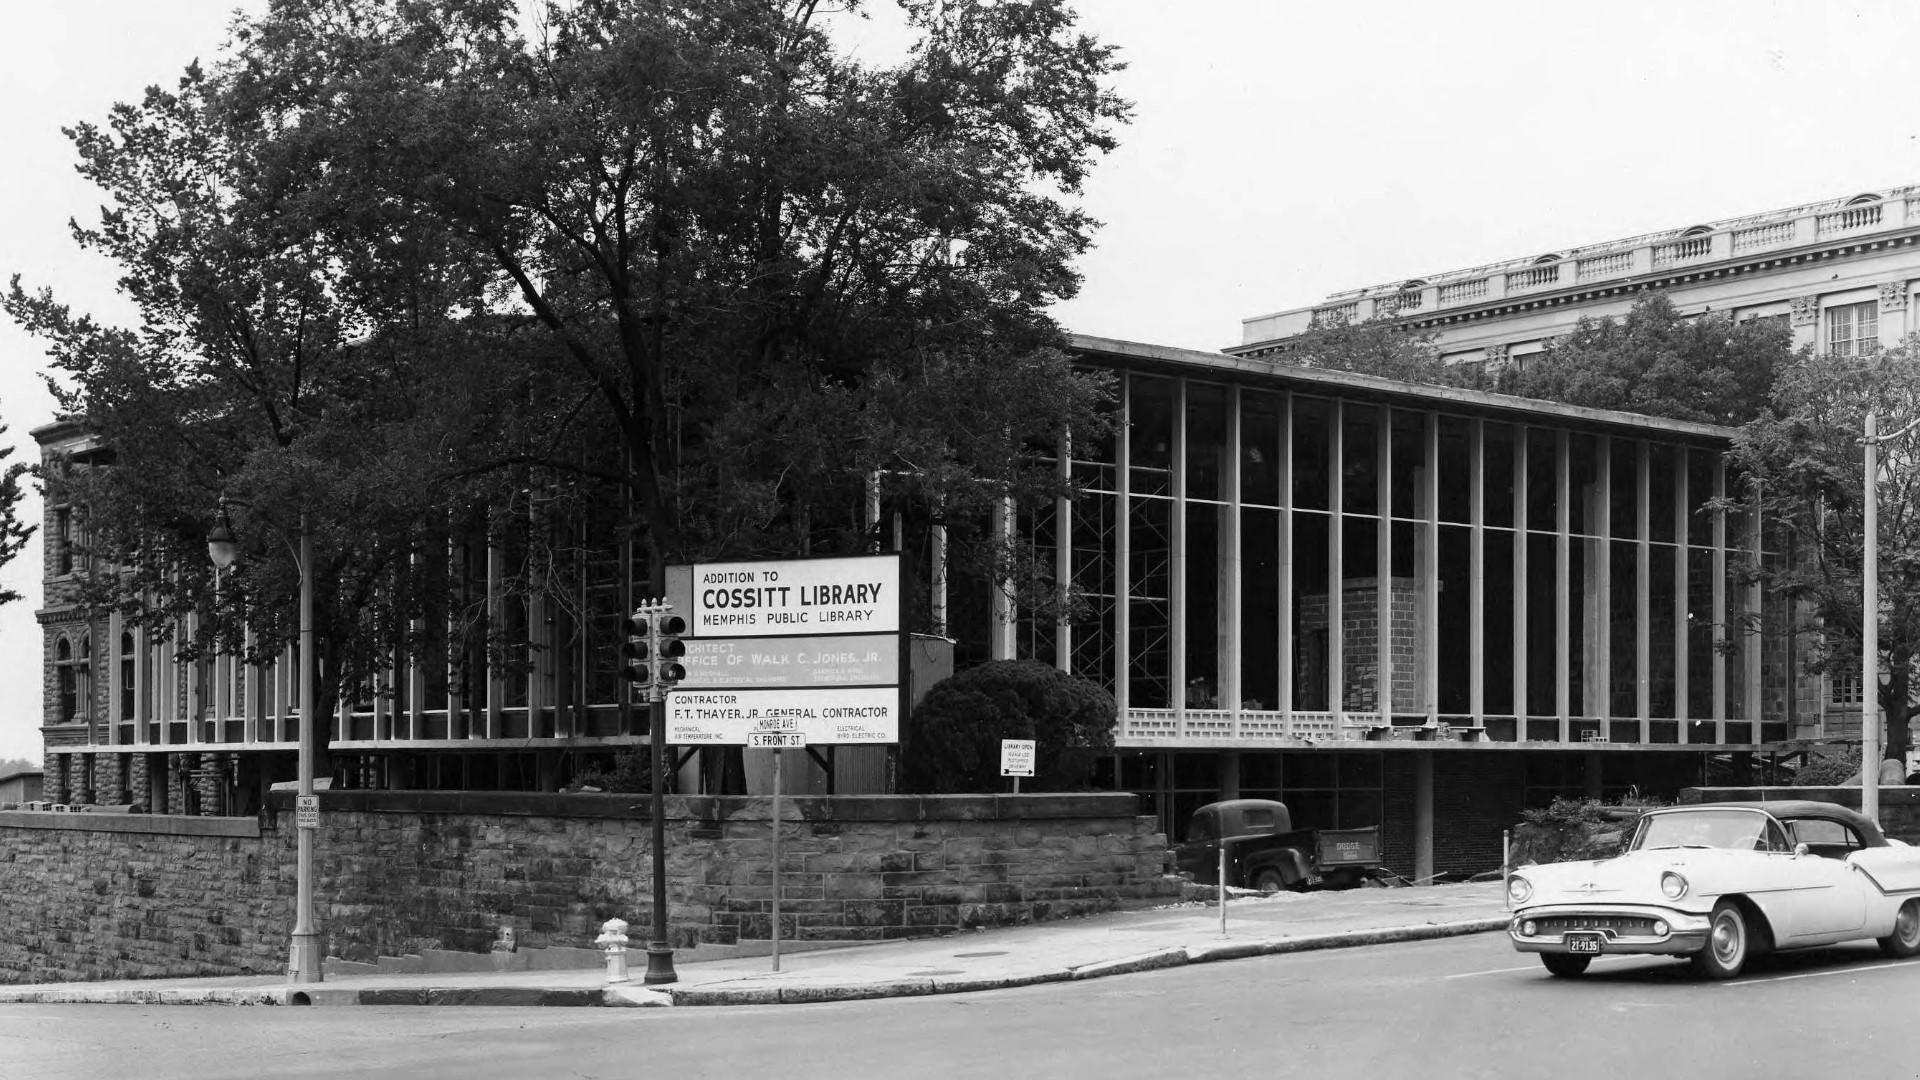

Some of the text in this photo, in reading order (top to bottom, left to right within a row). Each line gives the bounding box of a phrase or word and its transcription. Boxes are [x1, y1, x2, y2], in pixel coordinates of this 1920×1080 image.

[703, 571, 779, 584] ADDITION TO
[702, 582, 882, 610] COSSITT LIBRARY
[703, 609, 873, 626] MEMPHIS PUBLIC LIBRARY
[727, 653, 744, 665] OF
[674, 695, 737, 704] CONTRACTOR
[822, 706, 888, 718] CONTRACTOR
[759, 719, 780, 729] MONROE
[762, 735, 788, 746] FRONT
[1336, 842, 1359, 850] DODGE
